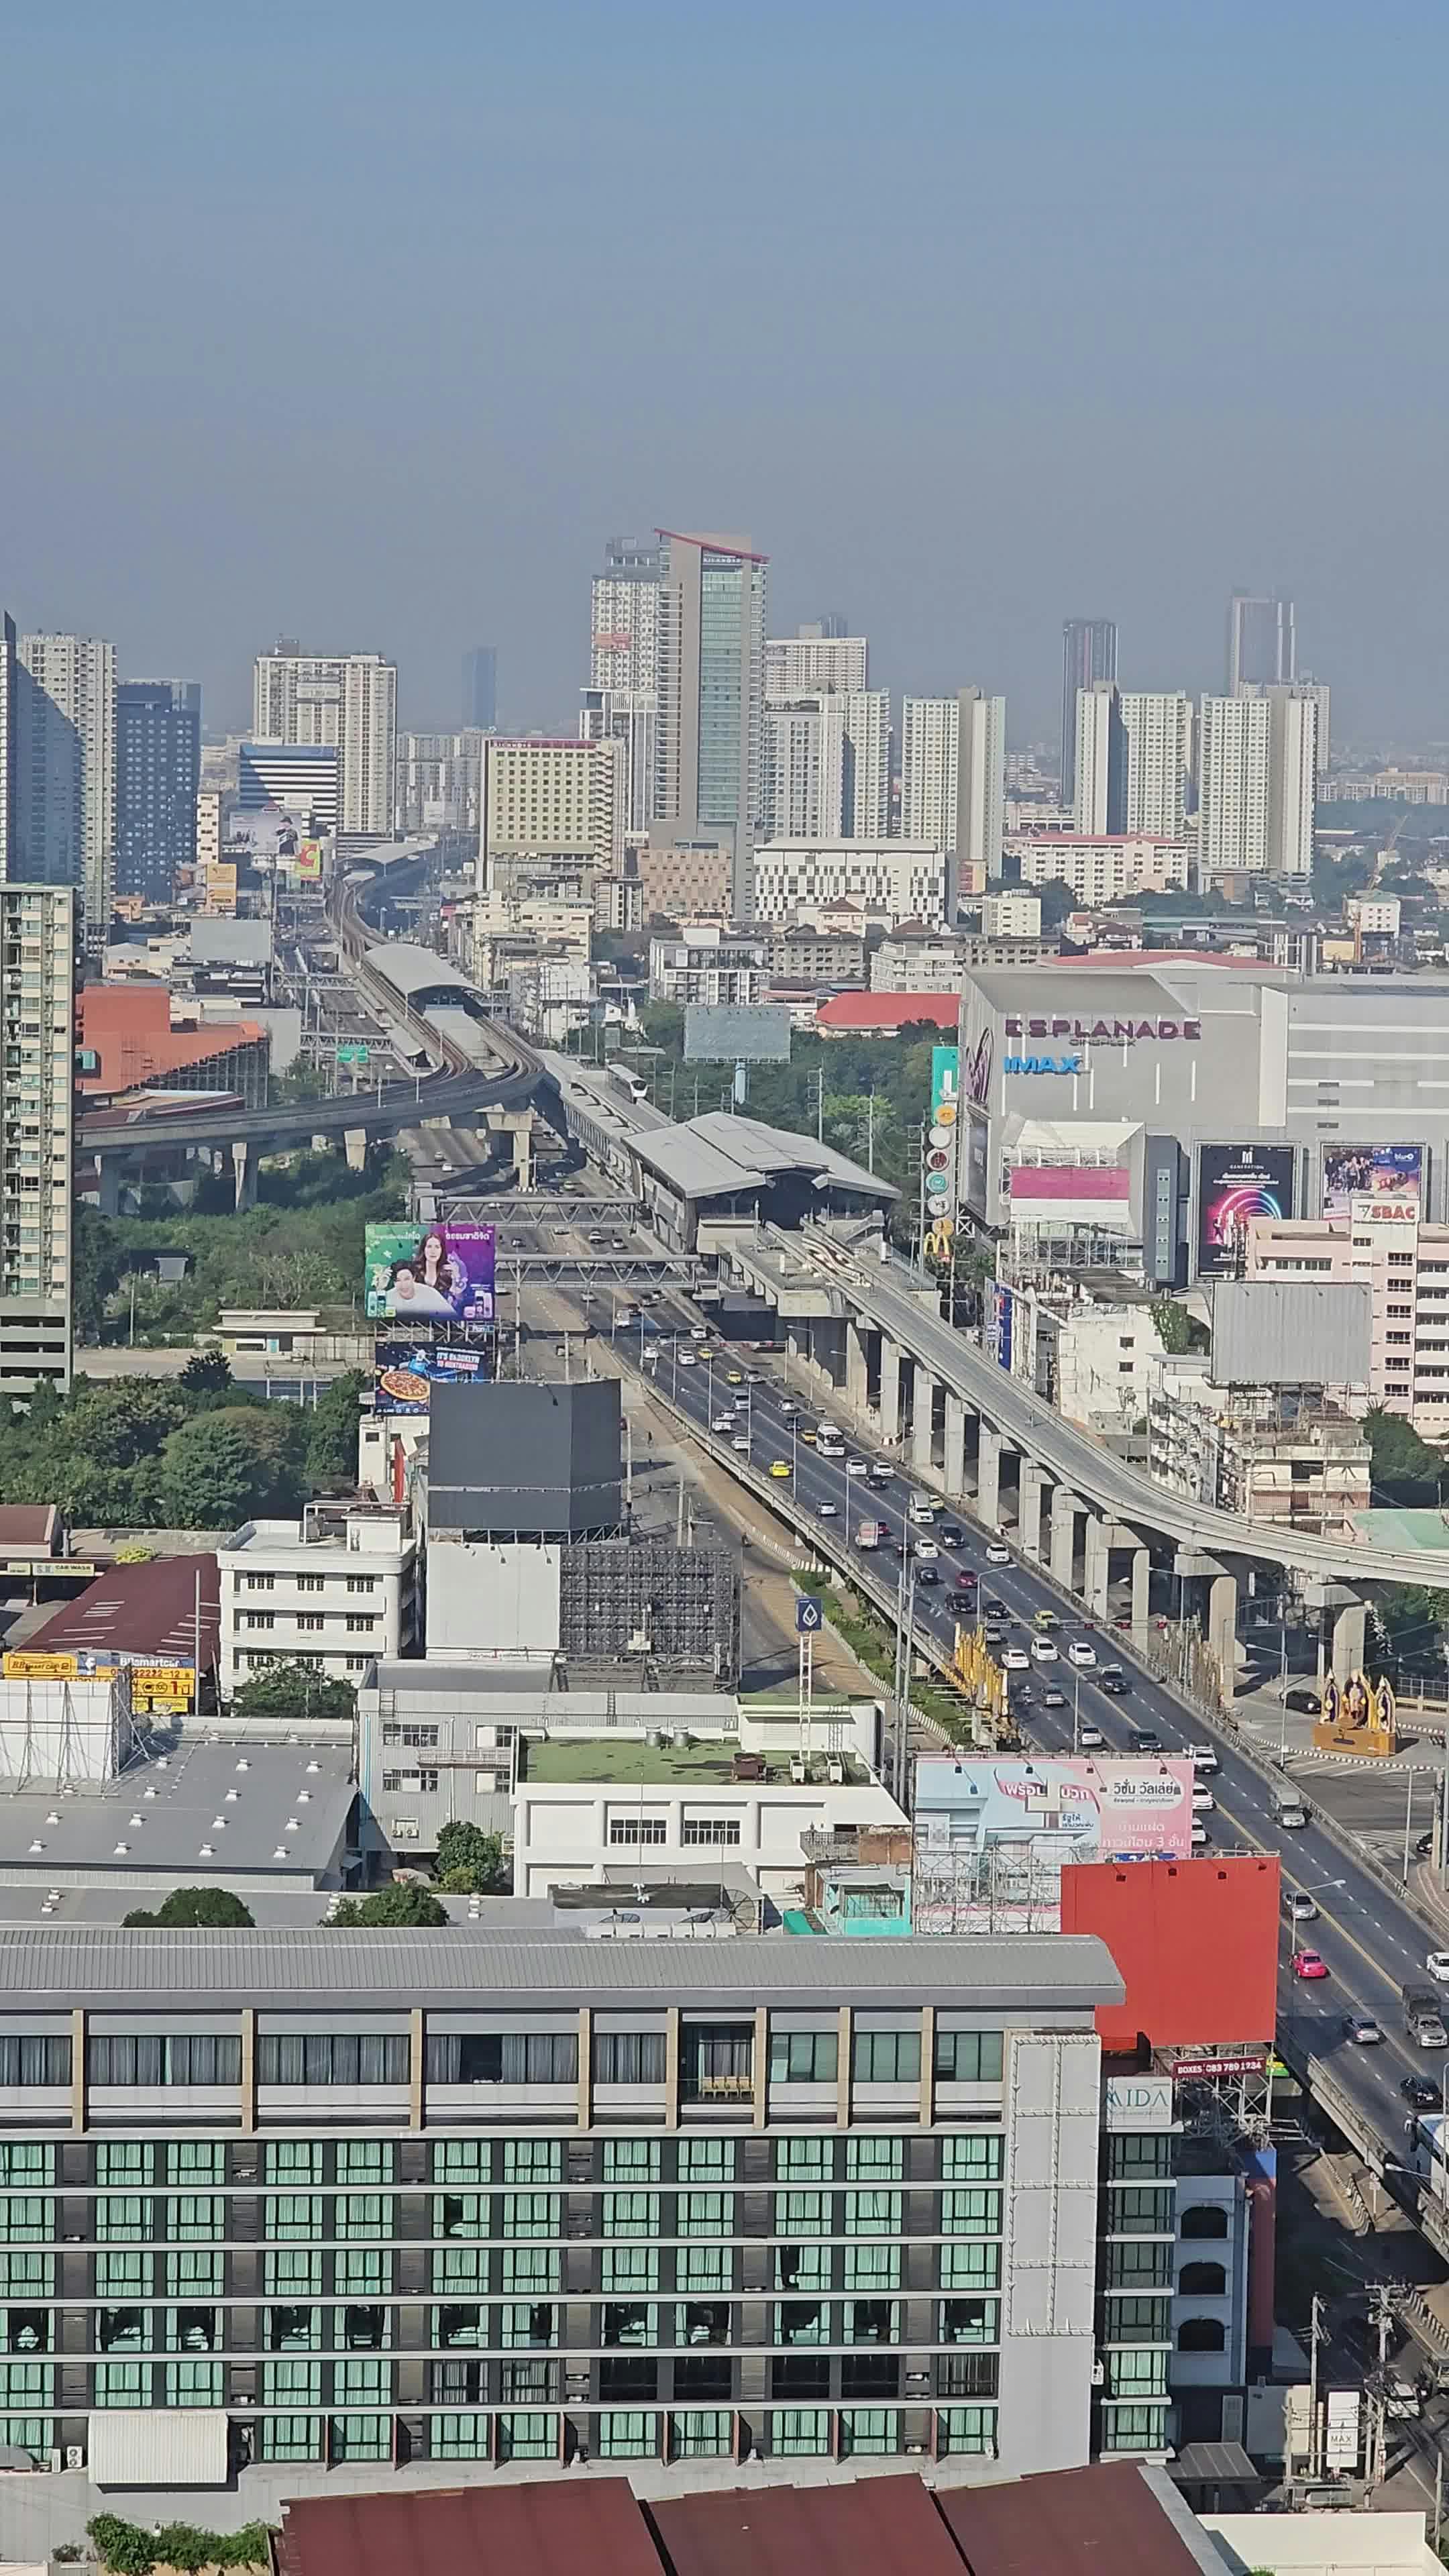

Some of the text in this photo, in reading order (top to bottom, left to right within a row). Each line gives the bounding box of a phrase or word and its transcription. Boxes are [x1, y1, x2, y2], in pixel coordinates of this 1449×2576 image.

[1005, 1019, 1201, 1040] ESPLANADE
[1003, 1055, 1082, 1075] IMAX
[1371, 1205, 1415, 1220] SBAC
[1156, 1836, 1165, 1847] 3
[1240, 2061, 1262, 2071] 1234
[1106, 2088, 1169, 2107] MIDA
